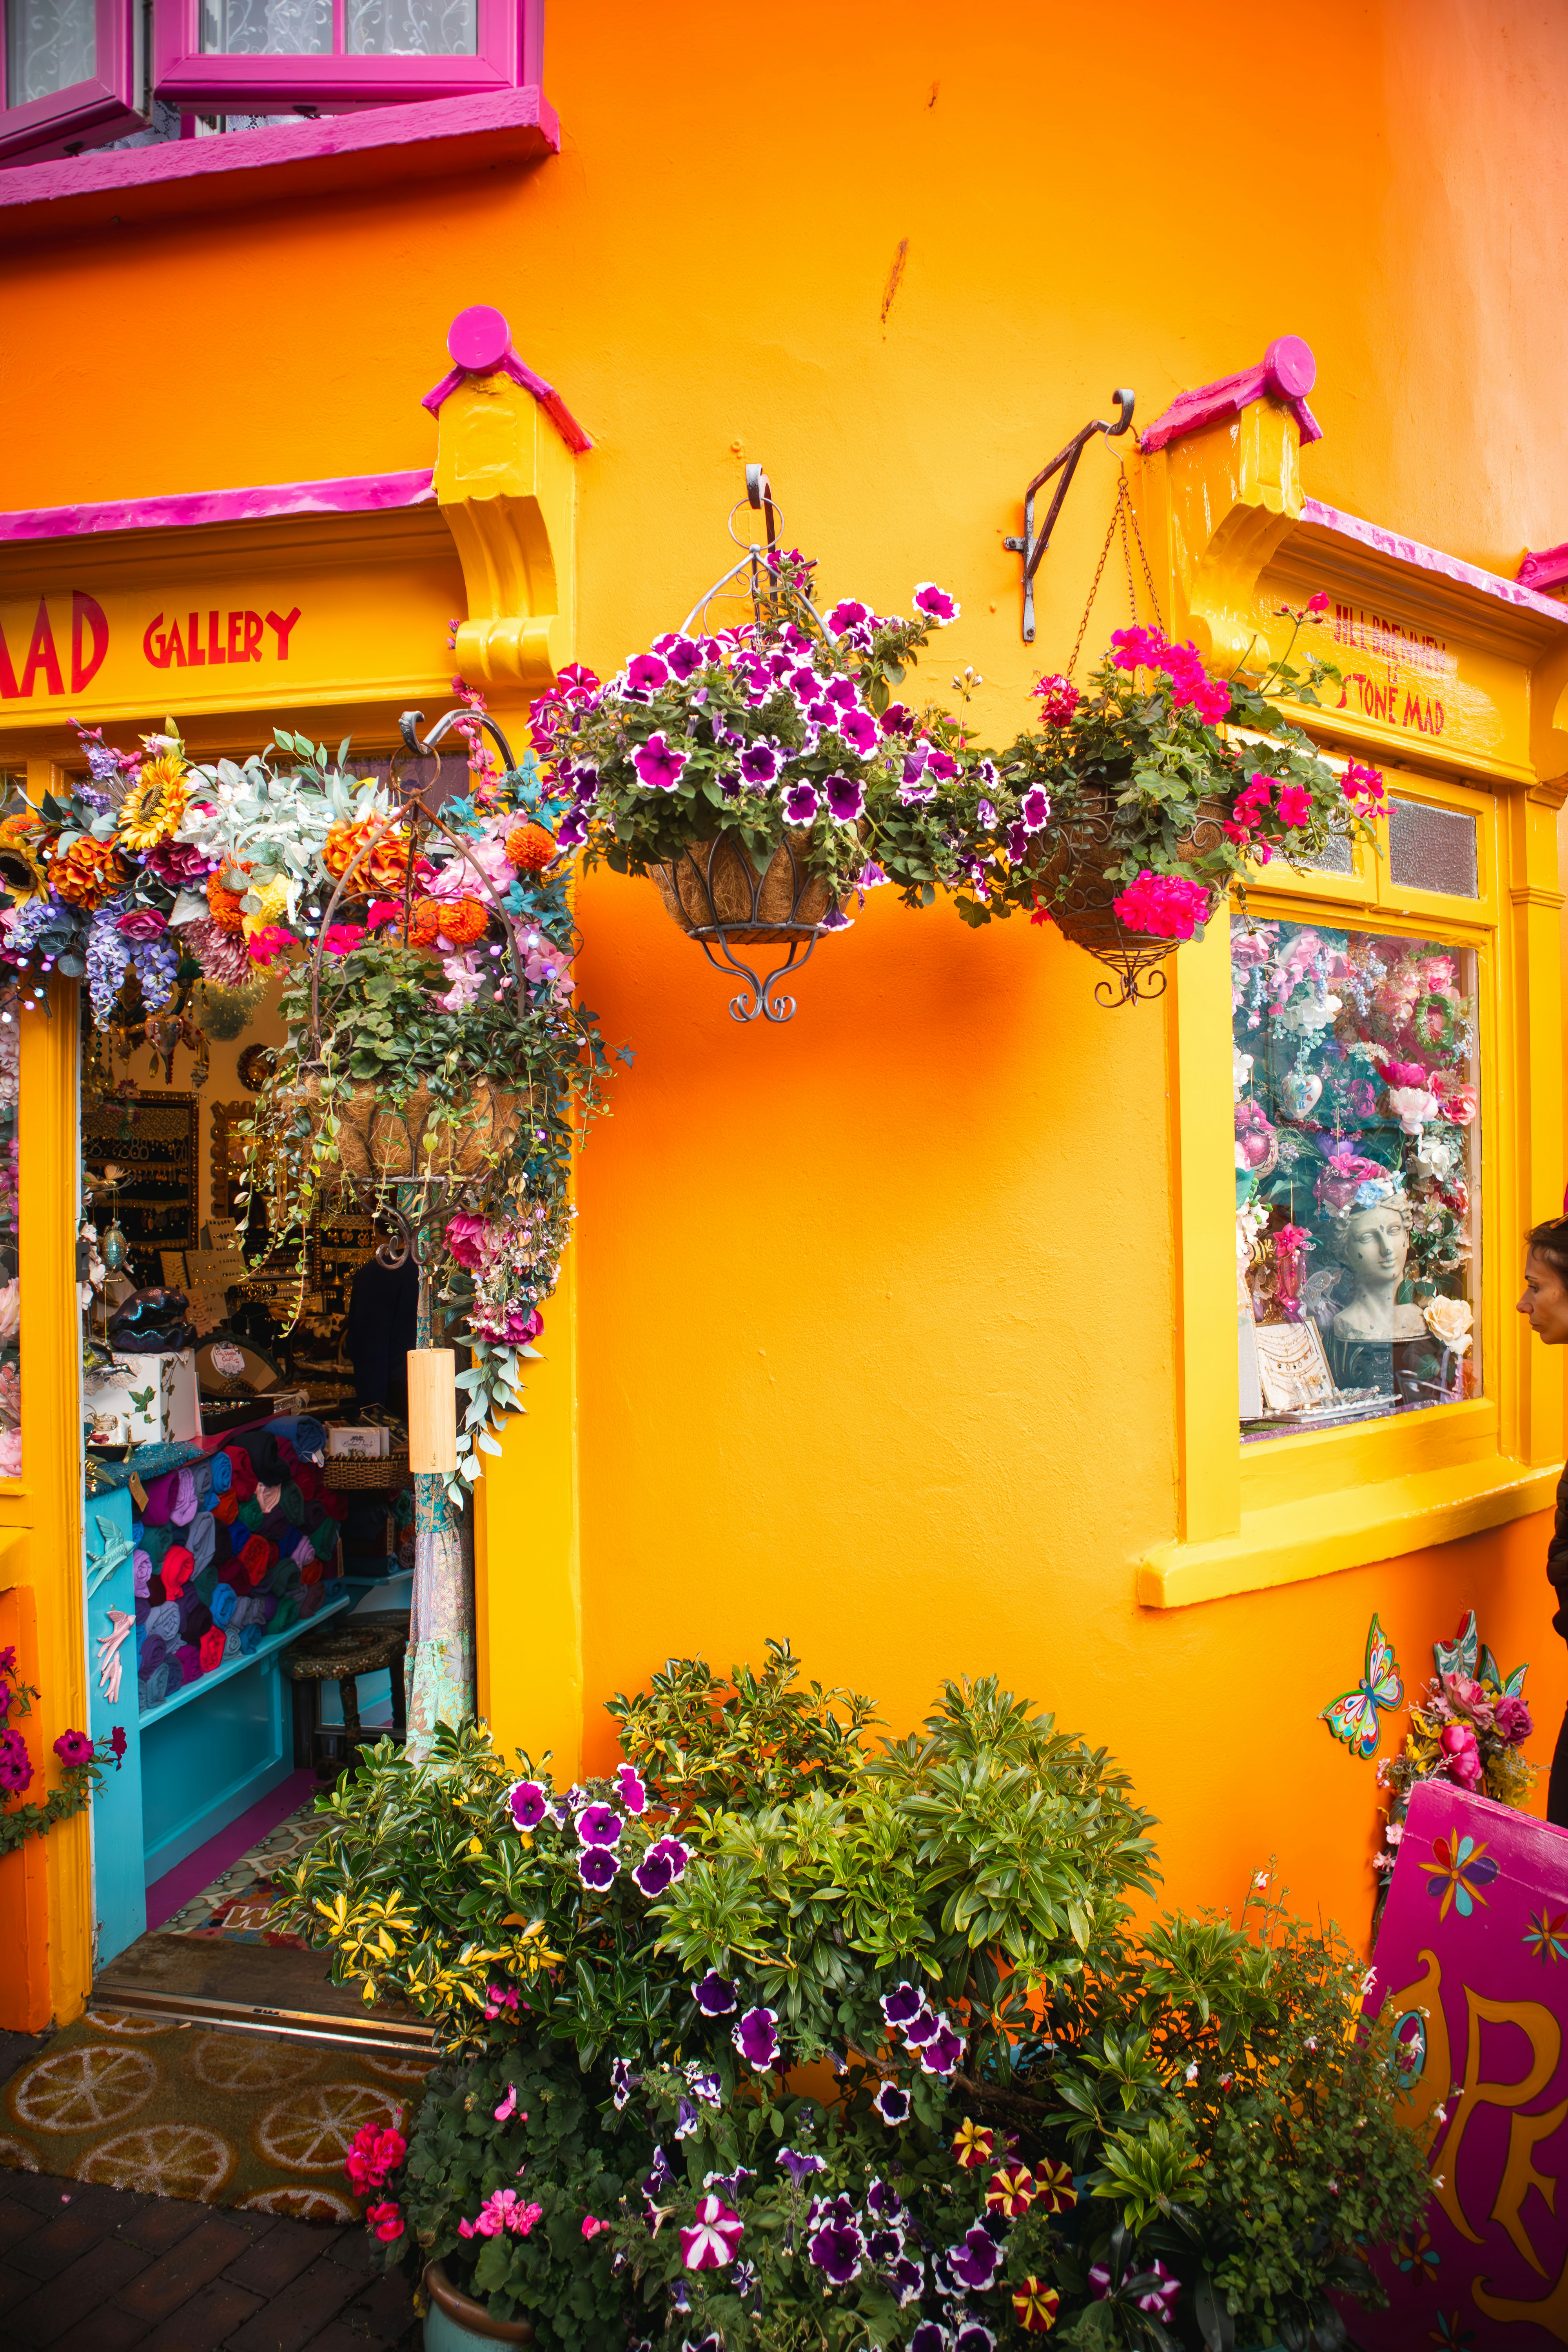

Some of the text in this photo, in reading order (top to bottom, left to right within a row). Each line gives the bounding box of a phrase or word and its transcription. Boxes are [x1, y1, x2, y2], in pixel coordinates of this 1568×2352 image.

[143, 607, 301, 668] GALLERY
[1334, 604, 1368, 652] JILL
[1388, 662, 1400, 684] IS
[1336, 673, 1444, 736] STONE MAD
